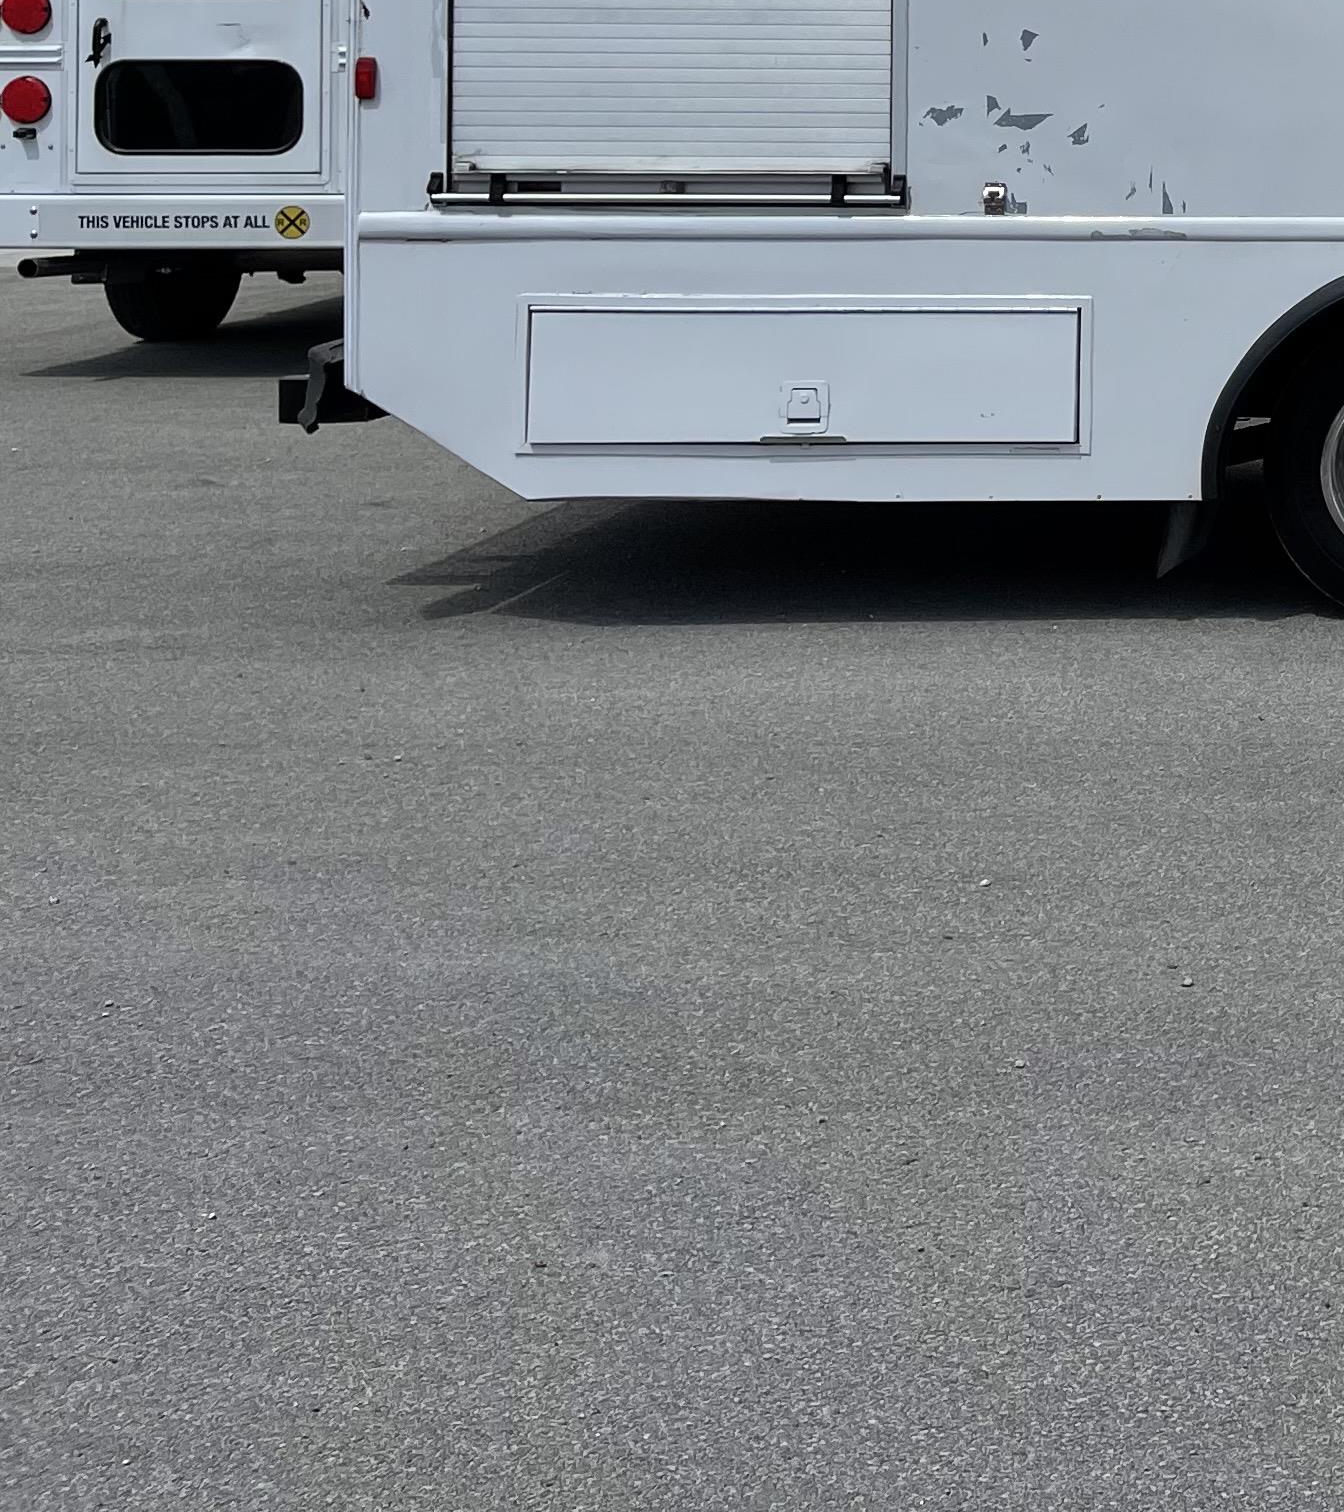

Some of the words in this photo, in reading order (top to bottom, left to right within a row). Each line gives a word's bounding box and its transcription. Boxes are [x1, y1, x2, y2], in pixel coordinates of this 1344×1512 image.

[78, 215, 109, 229] THIS
[112, 215, 171, 229] VEHICLE
[173, 215, 219, 229] STOPS
[222, 215, 240, 229] AT
[243, 215, 271, 229] ALL
